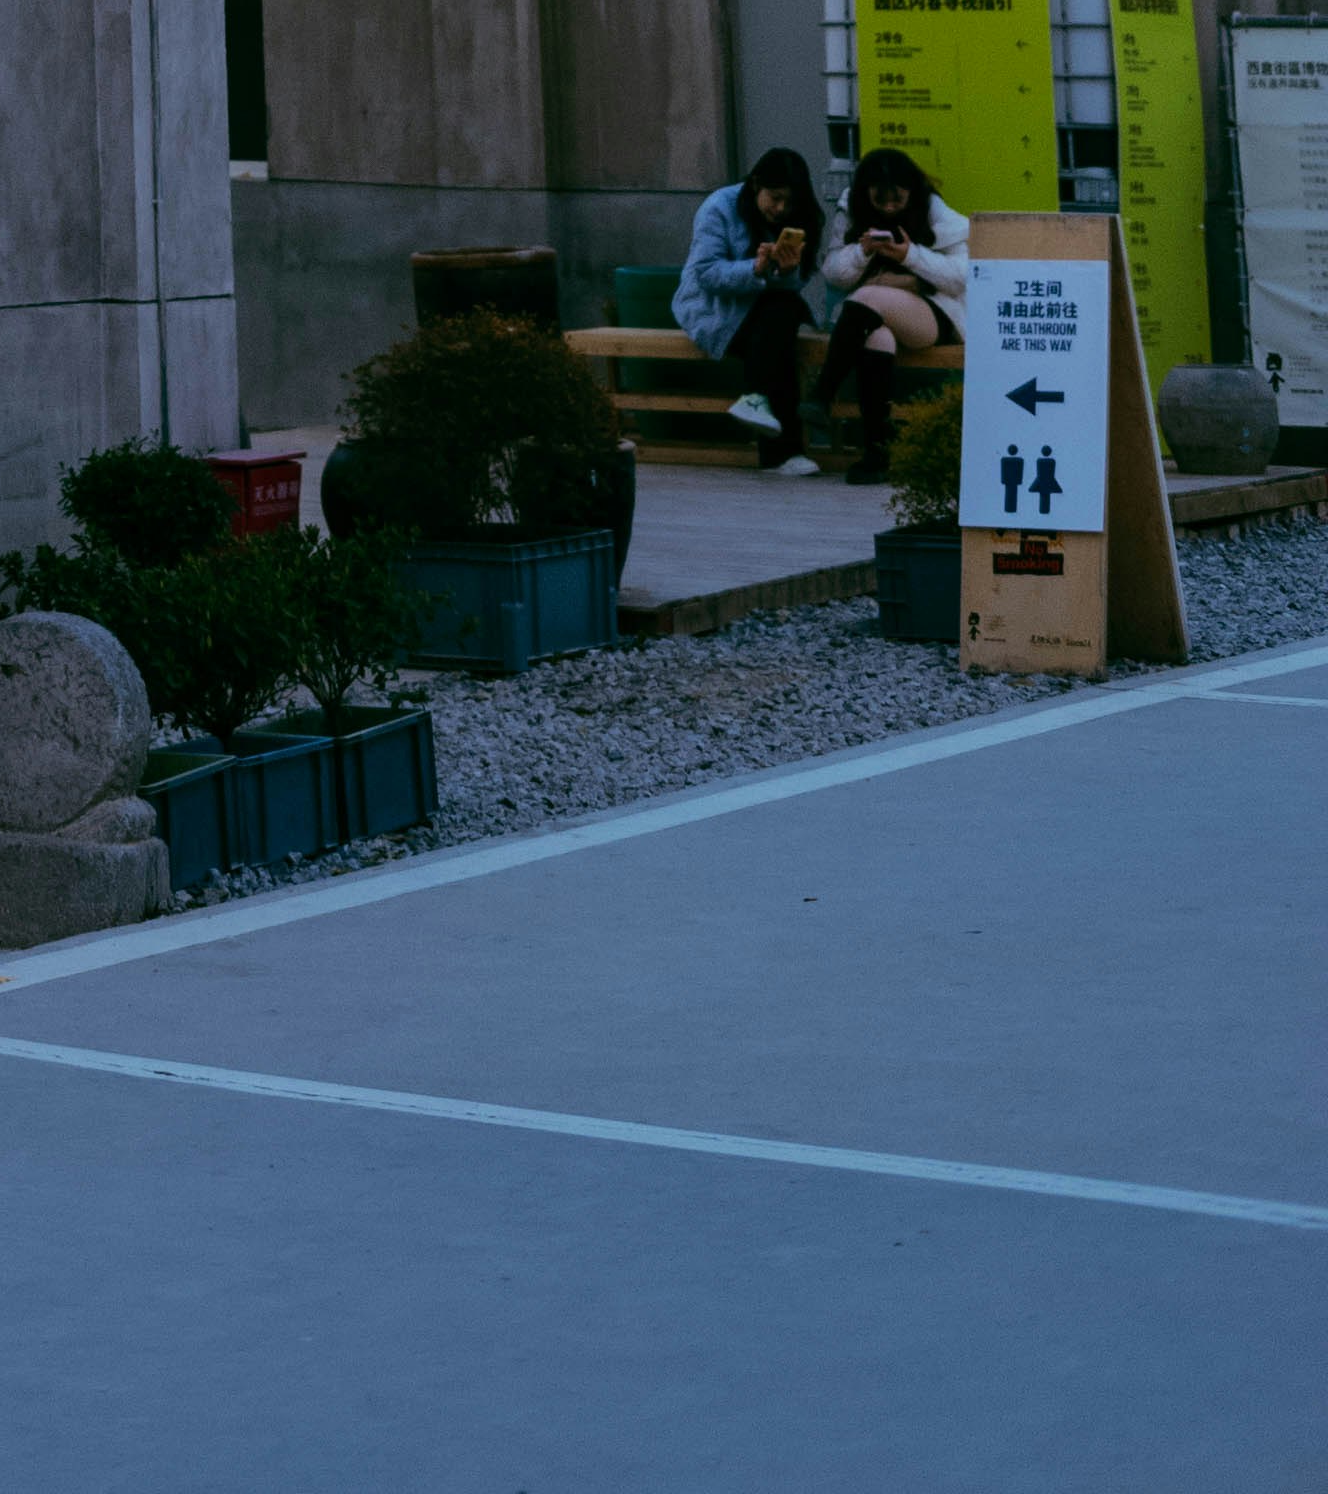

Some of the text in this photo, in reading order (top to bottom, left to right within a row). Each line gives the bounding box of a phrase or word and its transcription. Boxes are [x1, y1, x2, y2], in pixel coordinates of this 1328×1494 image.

[1013, 280, 1063, 298] 卫生间
[997, 301, 1079, 319] 请由此前往
[998, 321, 1077, 336] THE BATHROOM
[1001, 338, 1072, 352] ARE THIS WAY
[1024, 541, 1045, 555] No
[997, 557, 1060, 574] Smoking
